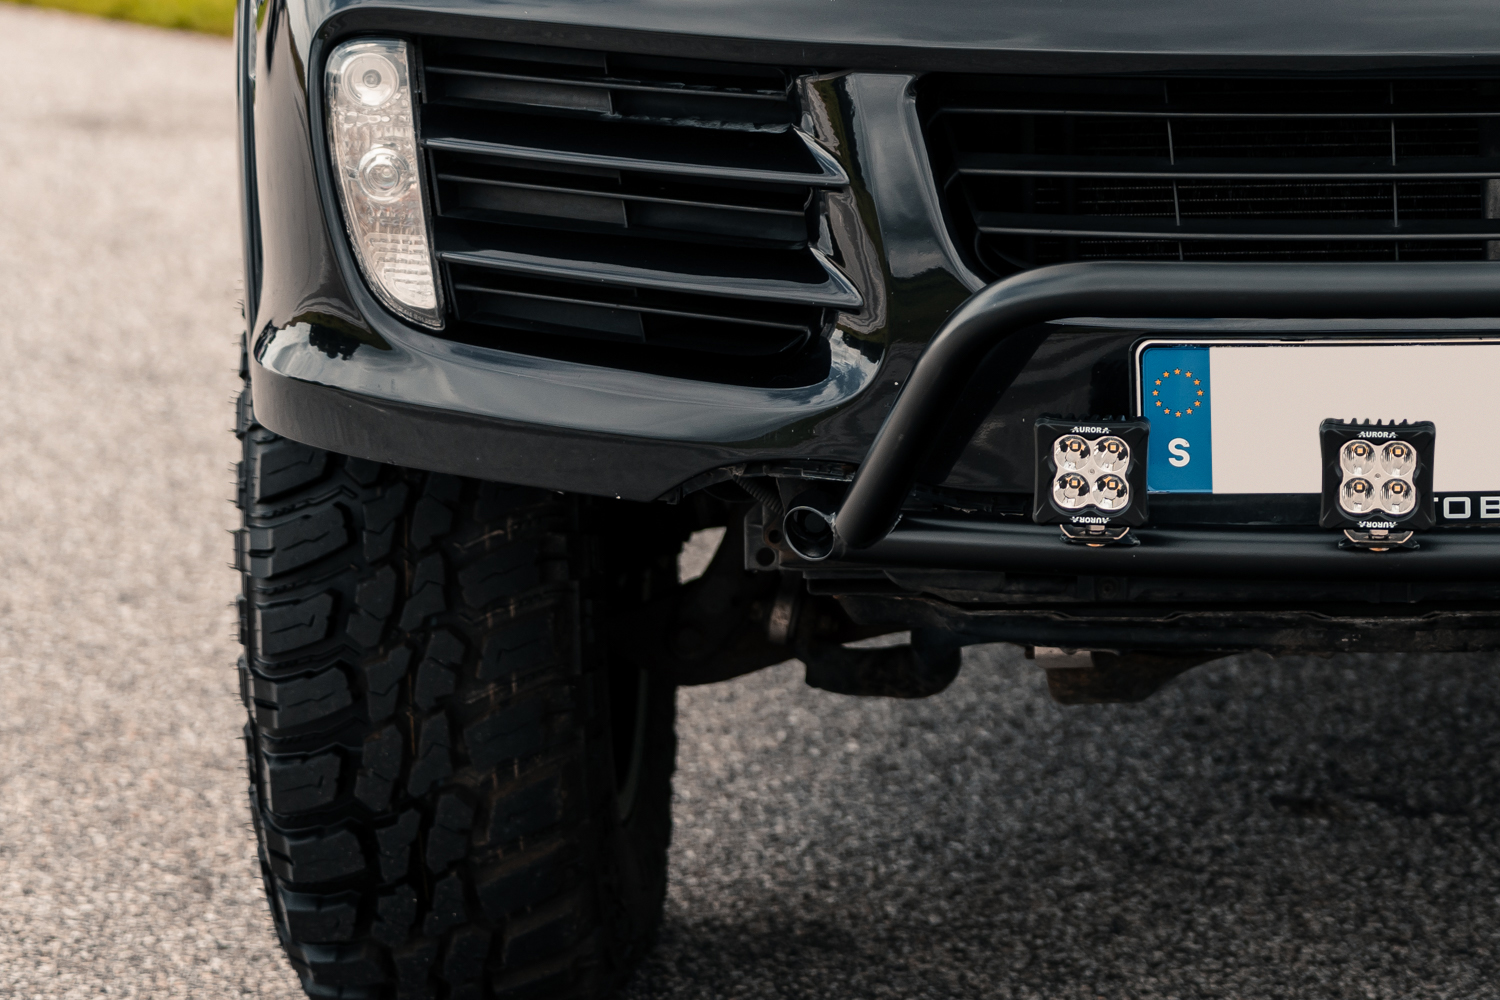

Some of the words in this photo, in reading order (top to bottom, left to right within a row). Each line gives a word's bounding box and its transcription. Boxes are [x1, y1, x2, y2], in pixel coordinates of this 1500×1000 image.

[1070, 426, 1112, 434] AURORA
[1357, 431, 1398, 439] AURORA
[1168, 437, 1190, 468] S
[1070, 516, 1111, 524] AURORA
[1357, 521, 1398, 529] AURORA
